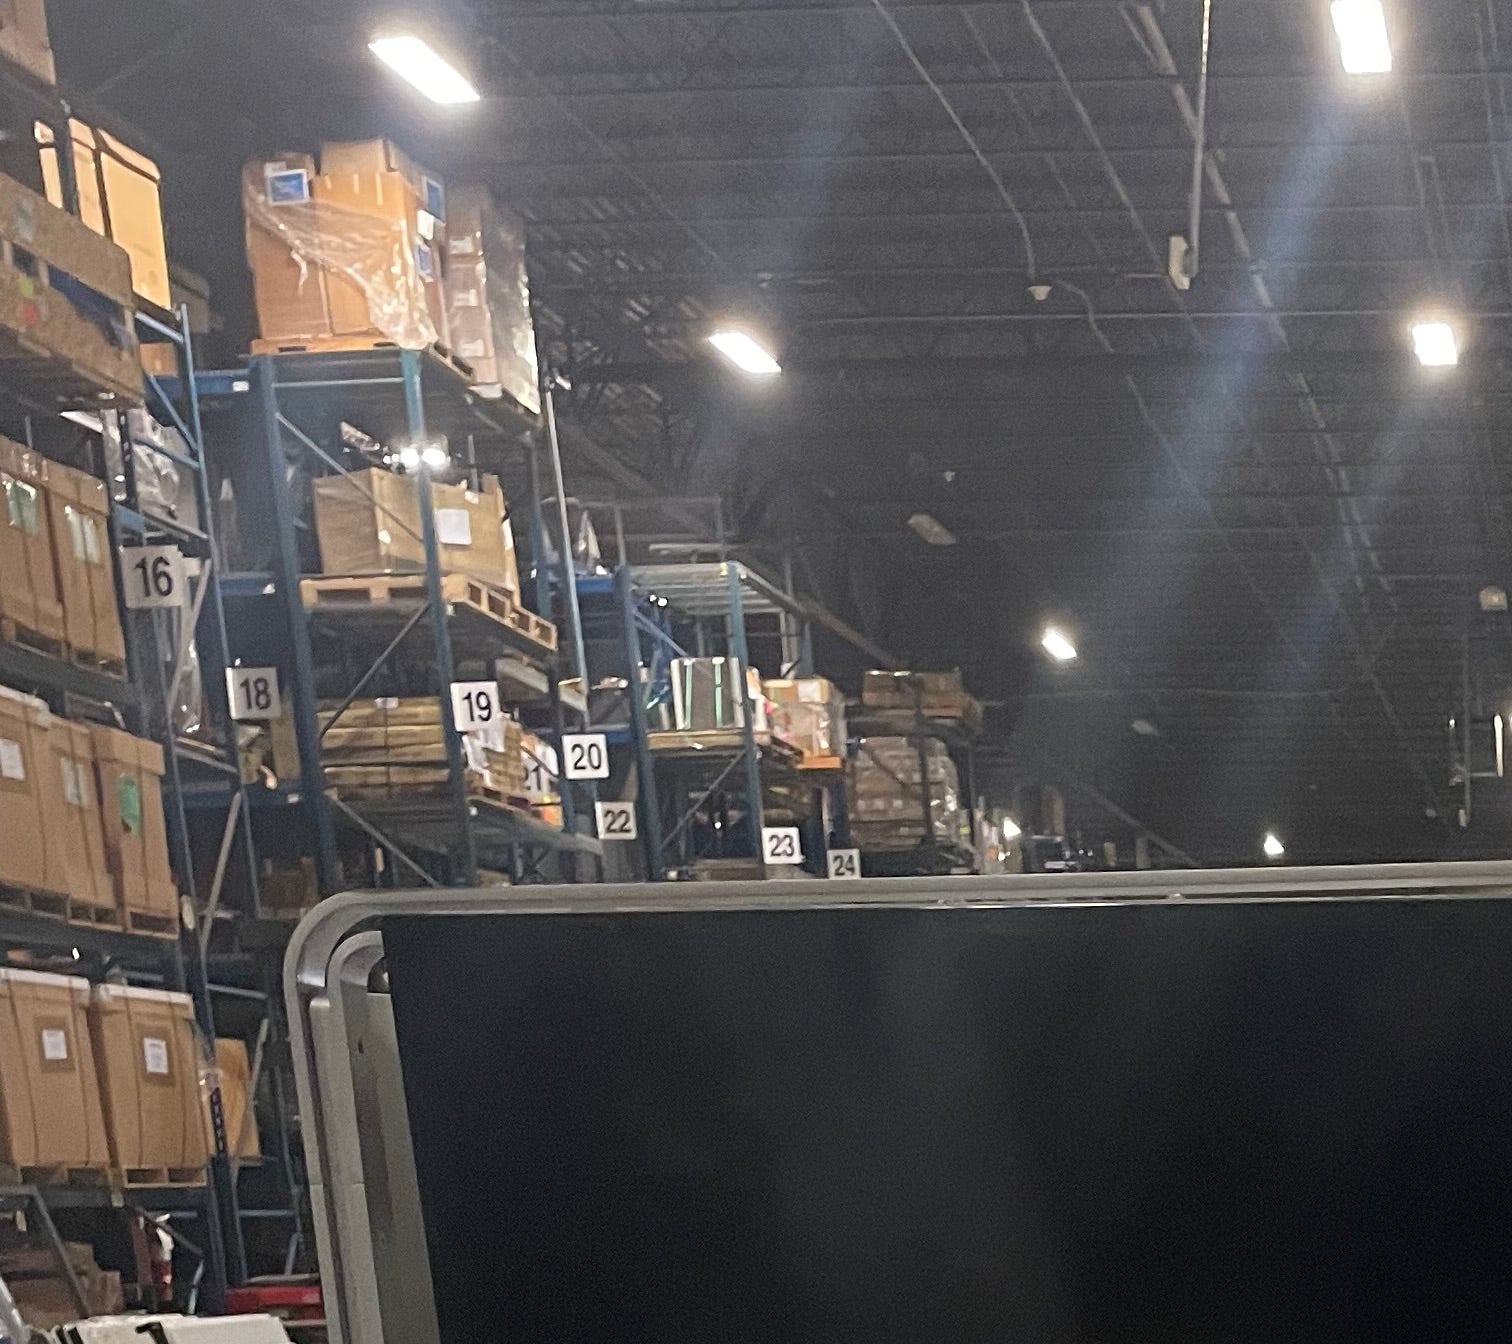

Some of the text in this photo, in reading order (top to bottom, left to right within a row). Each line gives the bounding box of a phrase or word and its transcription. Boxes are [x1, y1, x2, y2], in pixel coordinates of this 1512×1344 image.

[135, 556, 173, 597] 16
[239, 677, 271, 710] 18
[463, 691, 491, 722] 19
[572, 743, 602, 771] 20
[604, 809, 632, 834] 22
[769, 834, 795, 857] 23
[832, 854, 855, 877] 24
